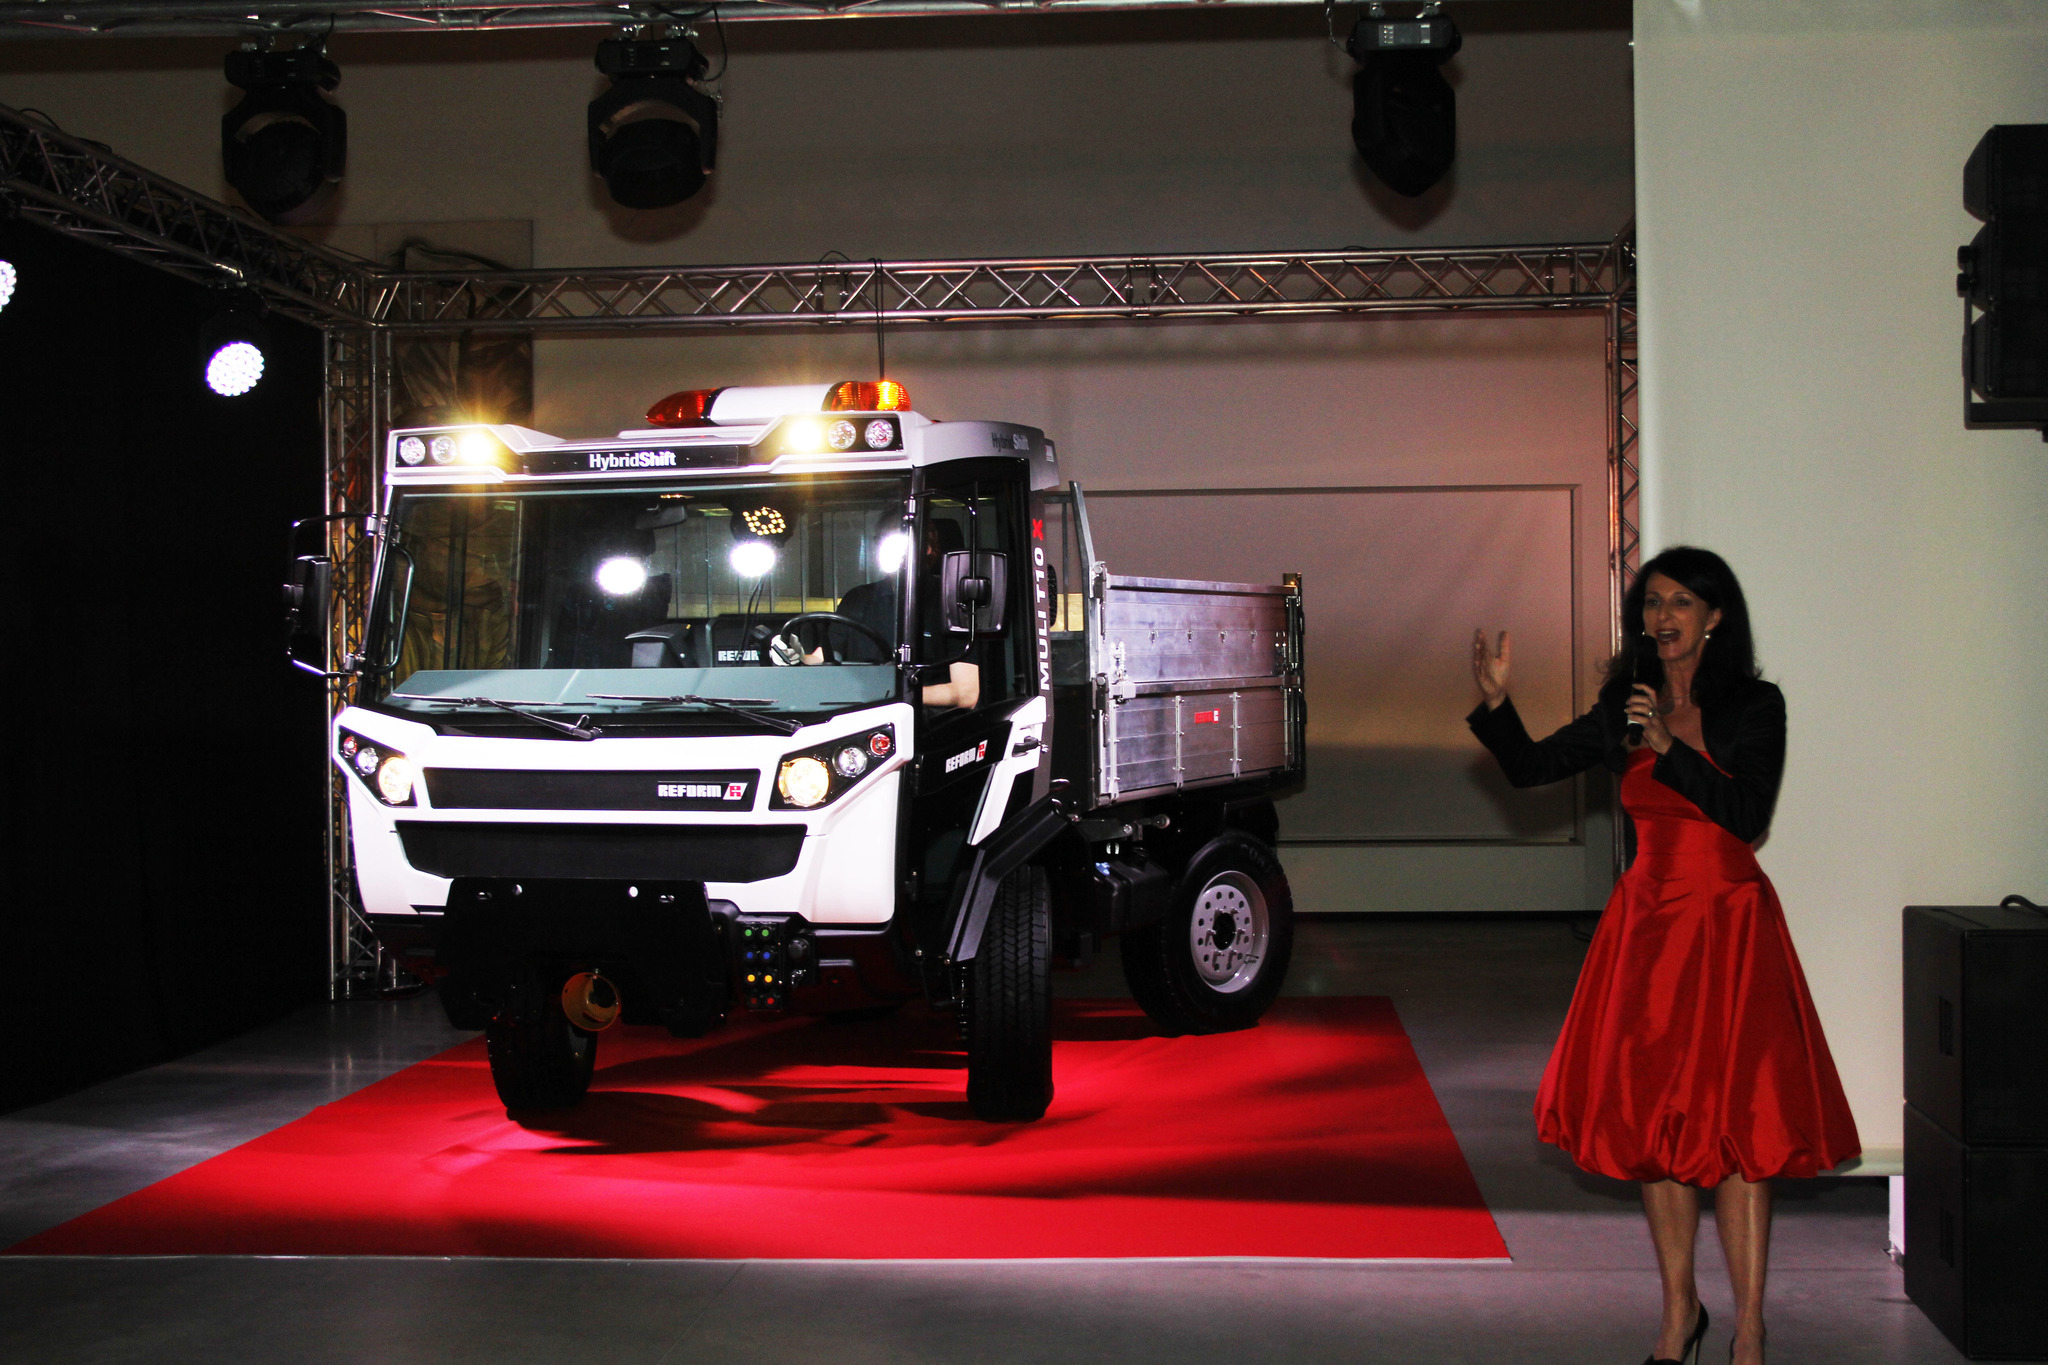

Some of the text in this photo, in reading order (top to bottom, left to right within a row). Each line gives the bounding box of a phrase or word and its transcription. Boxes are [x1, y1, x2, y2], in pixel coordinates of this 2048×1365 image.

[588, 450, 677, 471] HybridShift
[1032, 518, 1050, 691] MULI T10 X
[718, 650, 760, 661] REFOR
[945, 747, 977, 774] REFORM
[658, 784, 722, 798] REFORM
